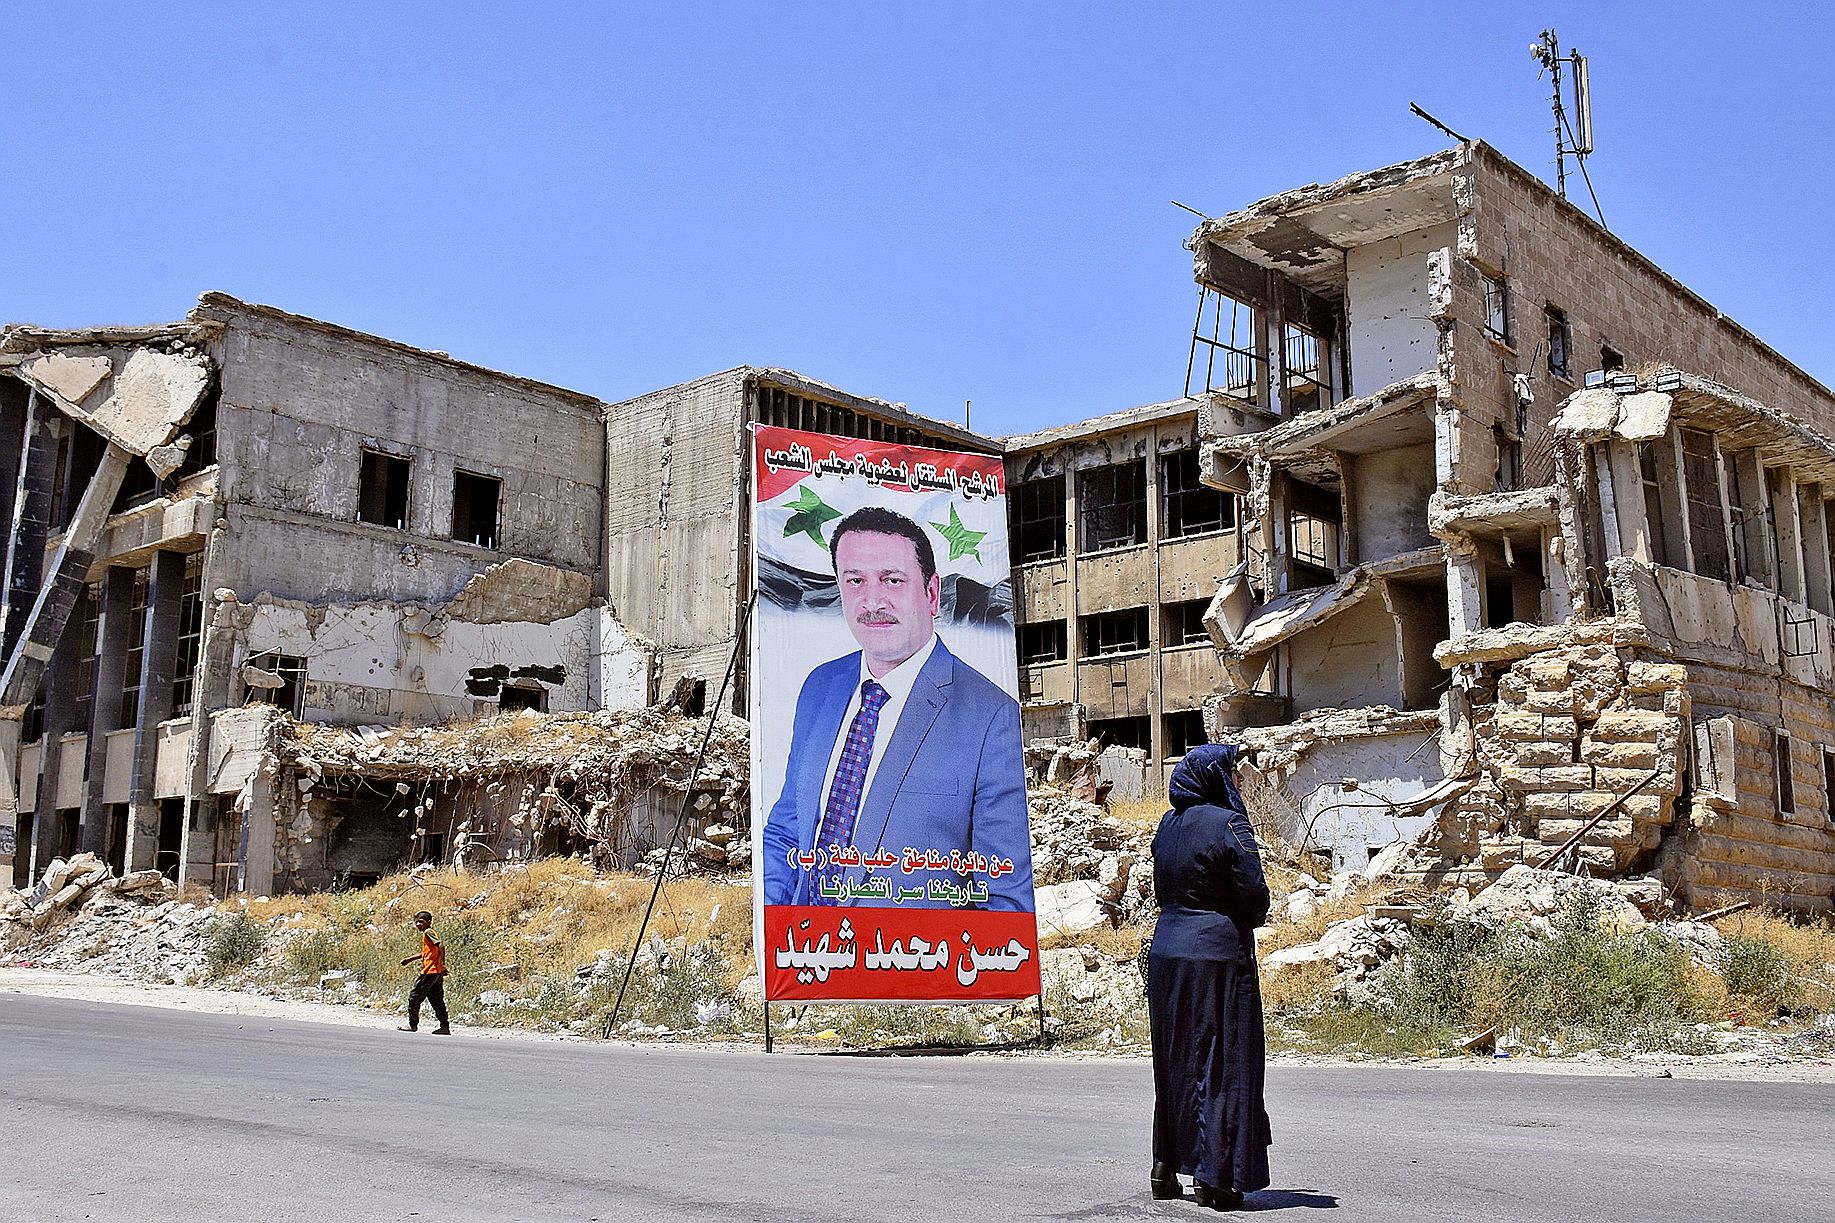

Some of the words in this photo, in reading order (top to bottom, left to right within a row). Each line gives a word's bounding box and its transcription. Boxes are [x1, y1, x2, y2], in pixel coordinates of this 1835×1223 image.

[765, 442, 812, 473] الشعب
[813, 451, 856, 482] مجلس
[856, 454, 908, 487] لعضوية
[909, 463, 957, 492] المستقل
[960, 471, 998, 502] المرشح
[828, 844, 861, 867] فئة
[862, 846, 899, 873] حلب
[902, 847, 950, 874] مناطق
[950, 849, 988, 876] دائرة
[989, 854, 1014, 878] عن
[819, 875, 893, 902] انتصارنا
[894, 885, 924, 904] سر
[927, 879, 988, 907] تاريخنا
[864, 927, 950, 971] محمد
[955, 930, 1031, 987] حسن
